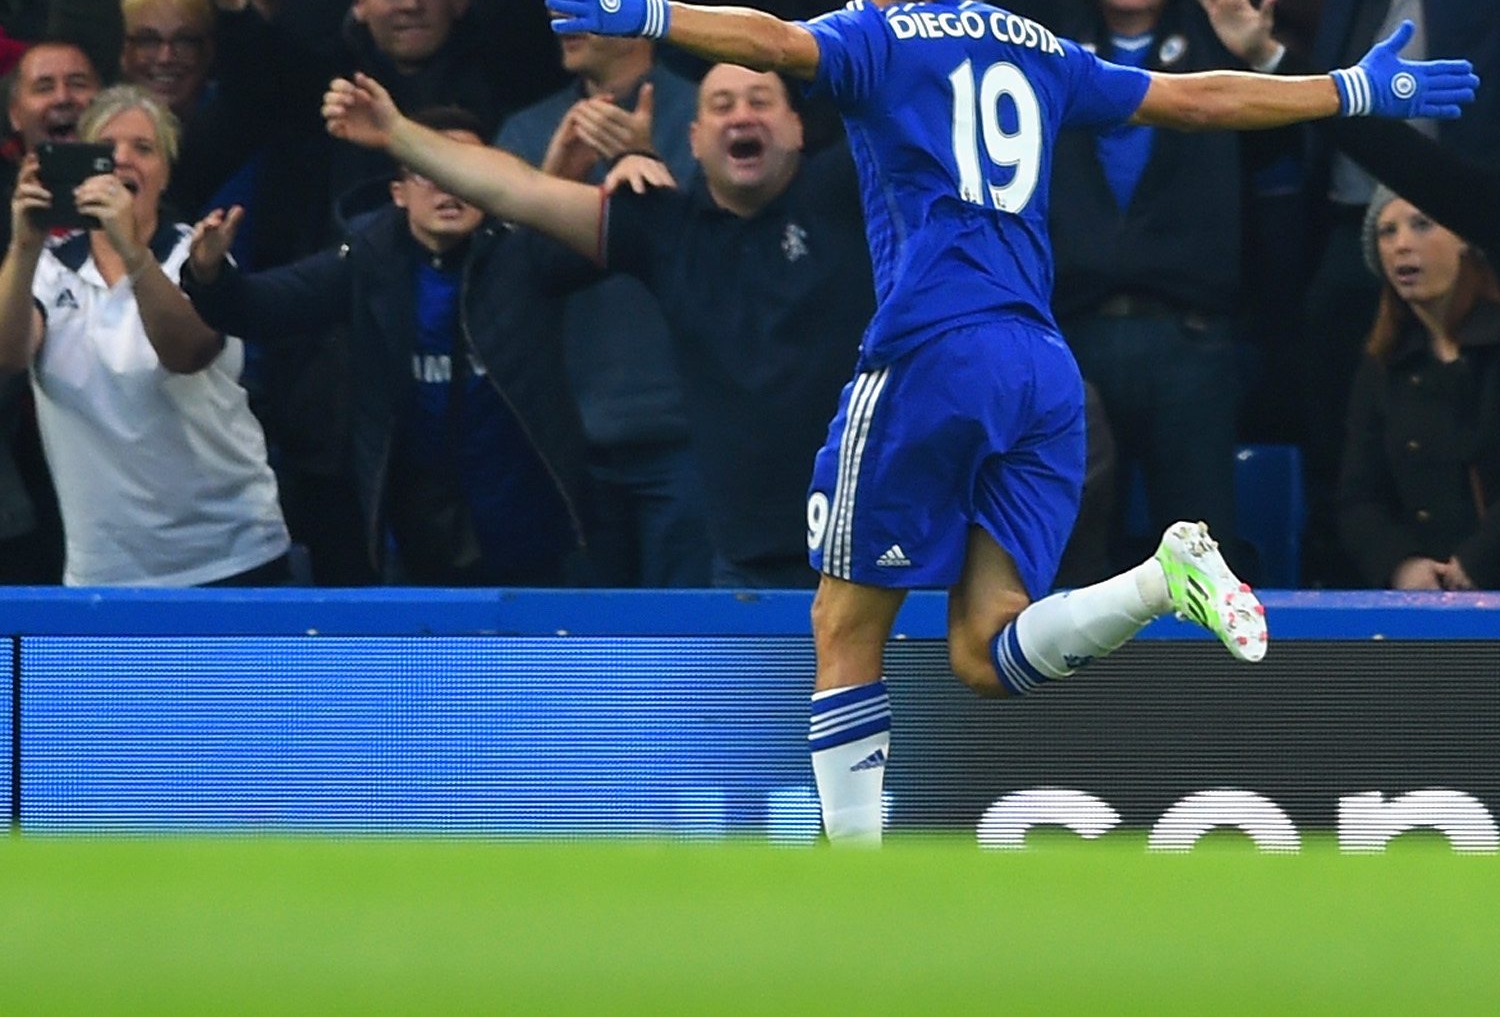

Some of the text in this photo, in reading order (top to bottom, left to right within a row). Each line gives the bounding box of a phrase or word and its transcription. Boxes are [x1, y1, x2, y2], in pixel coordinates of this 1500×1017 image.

[888, 11, 1066, 58] DIEGO COSTA
[948, 57, 1043, 215] 19
[807, 491, 829, 551] 9
